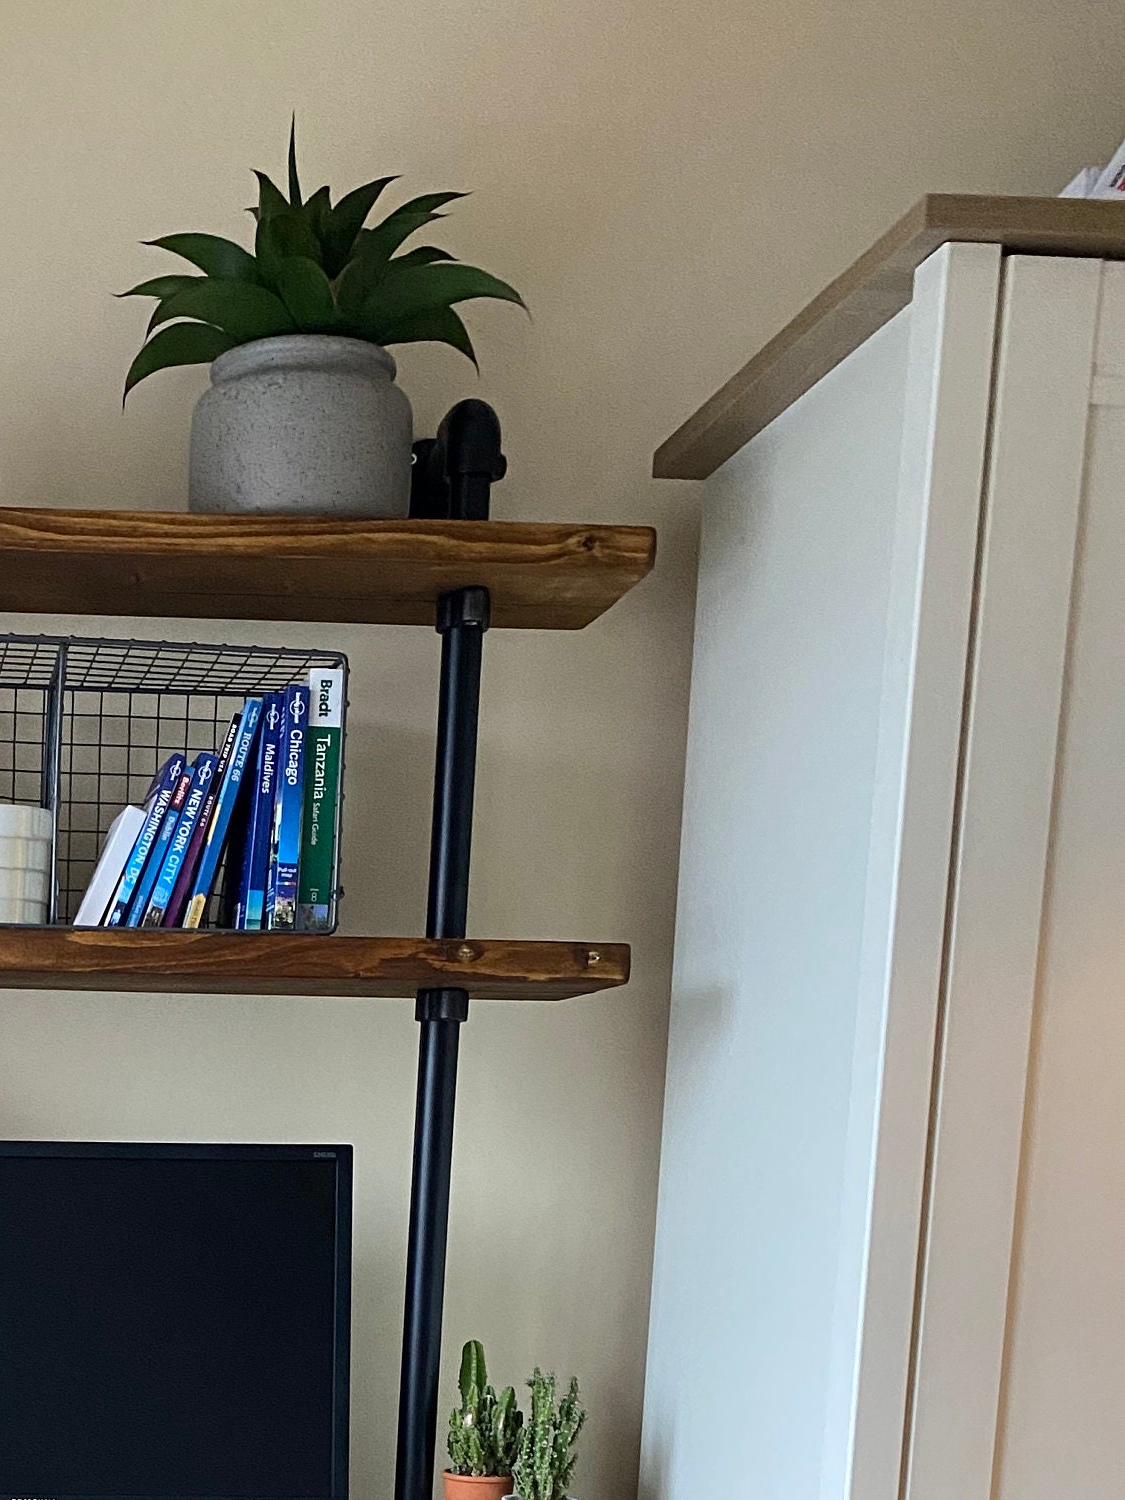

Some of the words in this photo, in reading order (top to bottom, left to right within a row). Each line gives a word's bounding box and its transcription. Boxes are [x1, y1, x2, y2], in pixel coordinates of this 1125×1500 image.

[318, 679, 333, 718] Bradt
[227, 723, 238, 743] ROAD
[235, 731, 252, 768] ROUTE
[285, 729, 303, 786] Chicago
[231, 769, 241, 782] 66
[261, 743, 276, 794] Maldives
[313, 733, 331, 799] Tanzania
[185, 788, 204, 820] NEW
[312, 802, 321, 822] Safari
[161, 816, 176, 841] Dublin
[172, 820, 193, 853] YORK
[310, 823, 319, 846] Guide
[128, 866, 139, 885] DC
[163, 854, 180, 884] CITY
